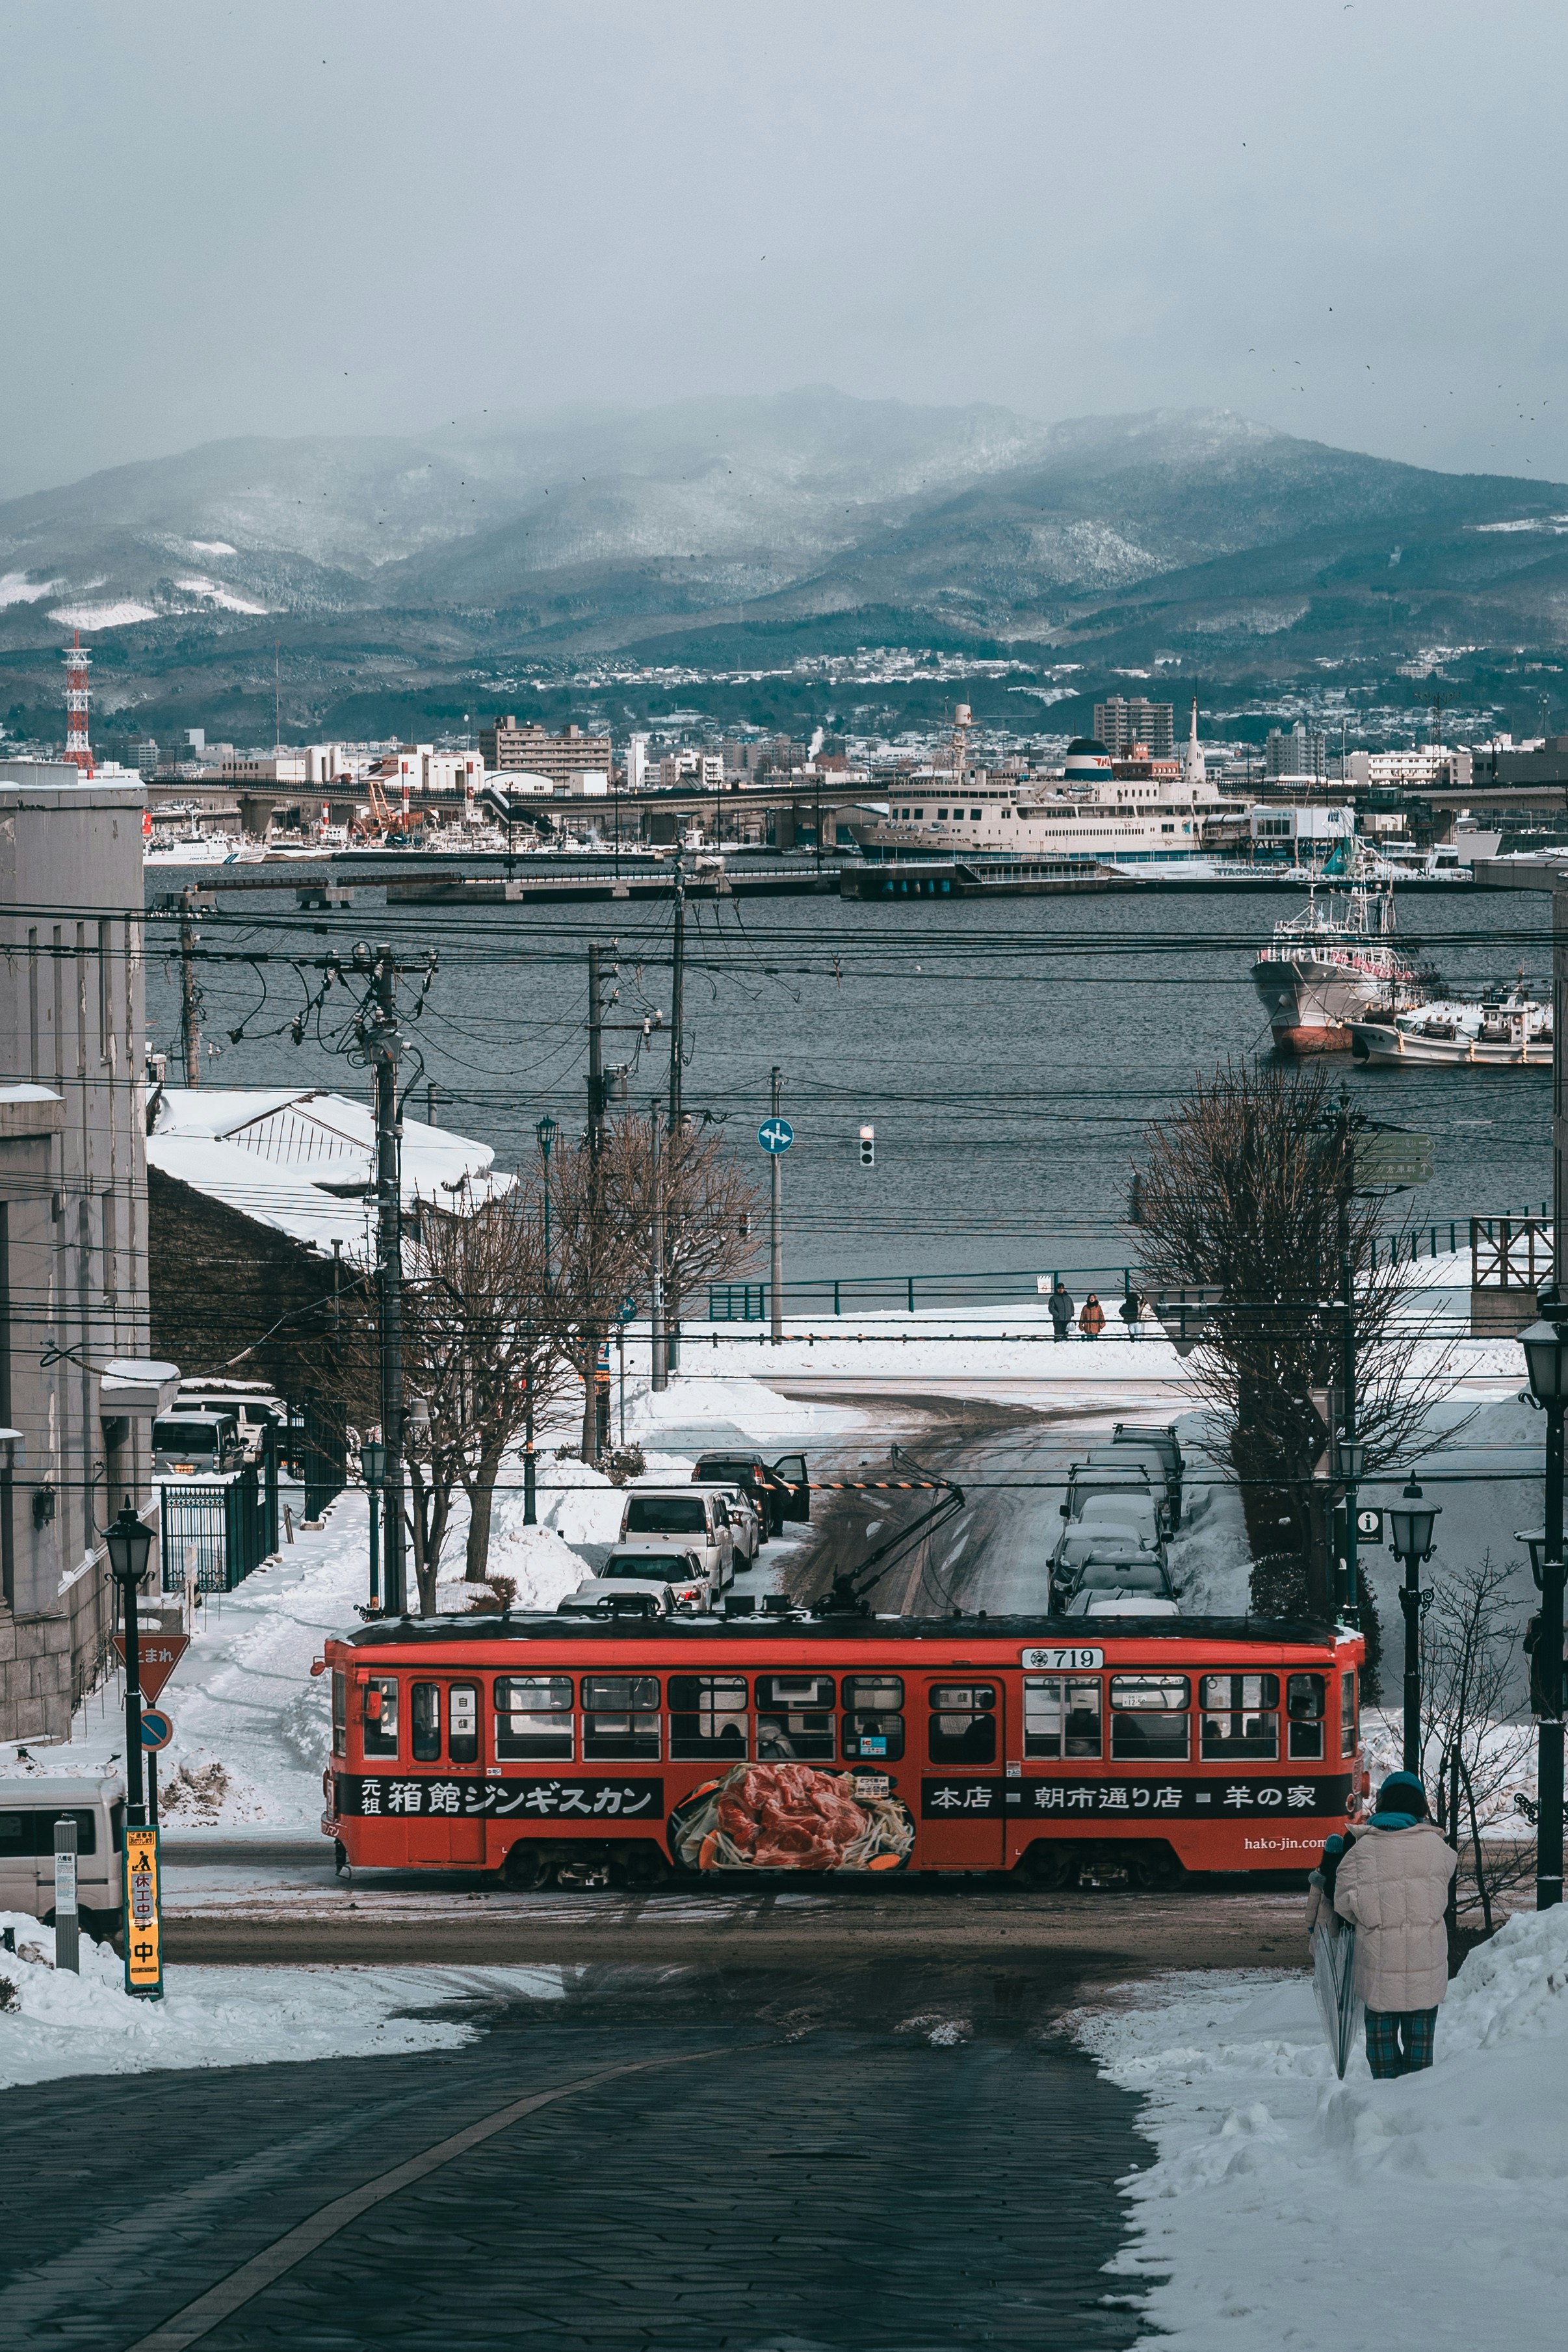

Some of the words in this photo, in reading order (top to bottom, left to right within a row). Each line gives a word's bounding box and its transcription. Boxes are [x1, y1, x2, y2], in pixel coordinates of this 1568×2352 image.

[1053, 1650, 1094, 1667] 719
[361, 1779, 382, 1815] 元祖
[388, 1782, 651, 1814] 箱館ジンギスカン
[931, 1786, 992, 1809] 本店
[1034, 1786, 1183, 1809] 朝市通り店
[1223, 1785, 1316, 1809] 羊の家
[1244, 1838, 1327, 1851] hako-jin.com
[135, 1875, 150, 1914] 休工中
